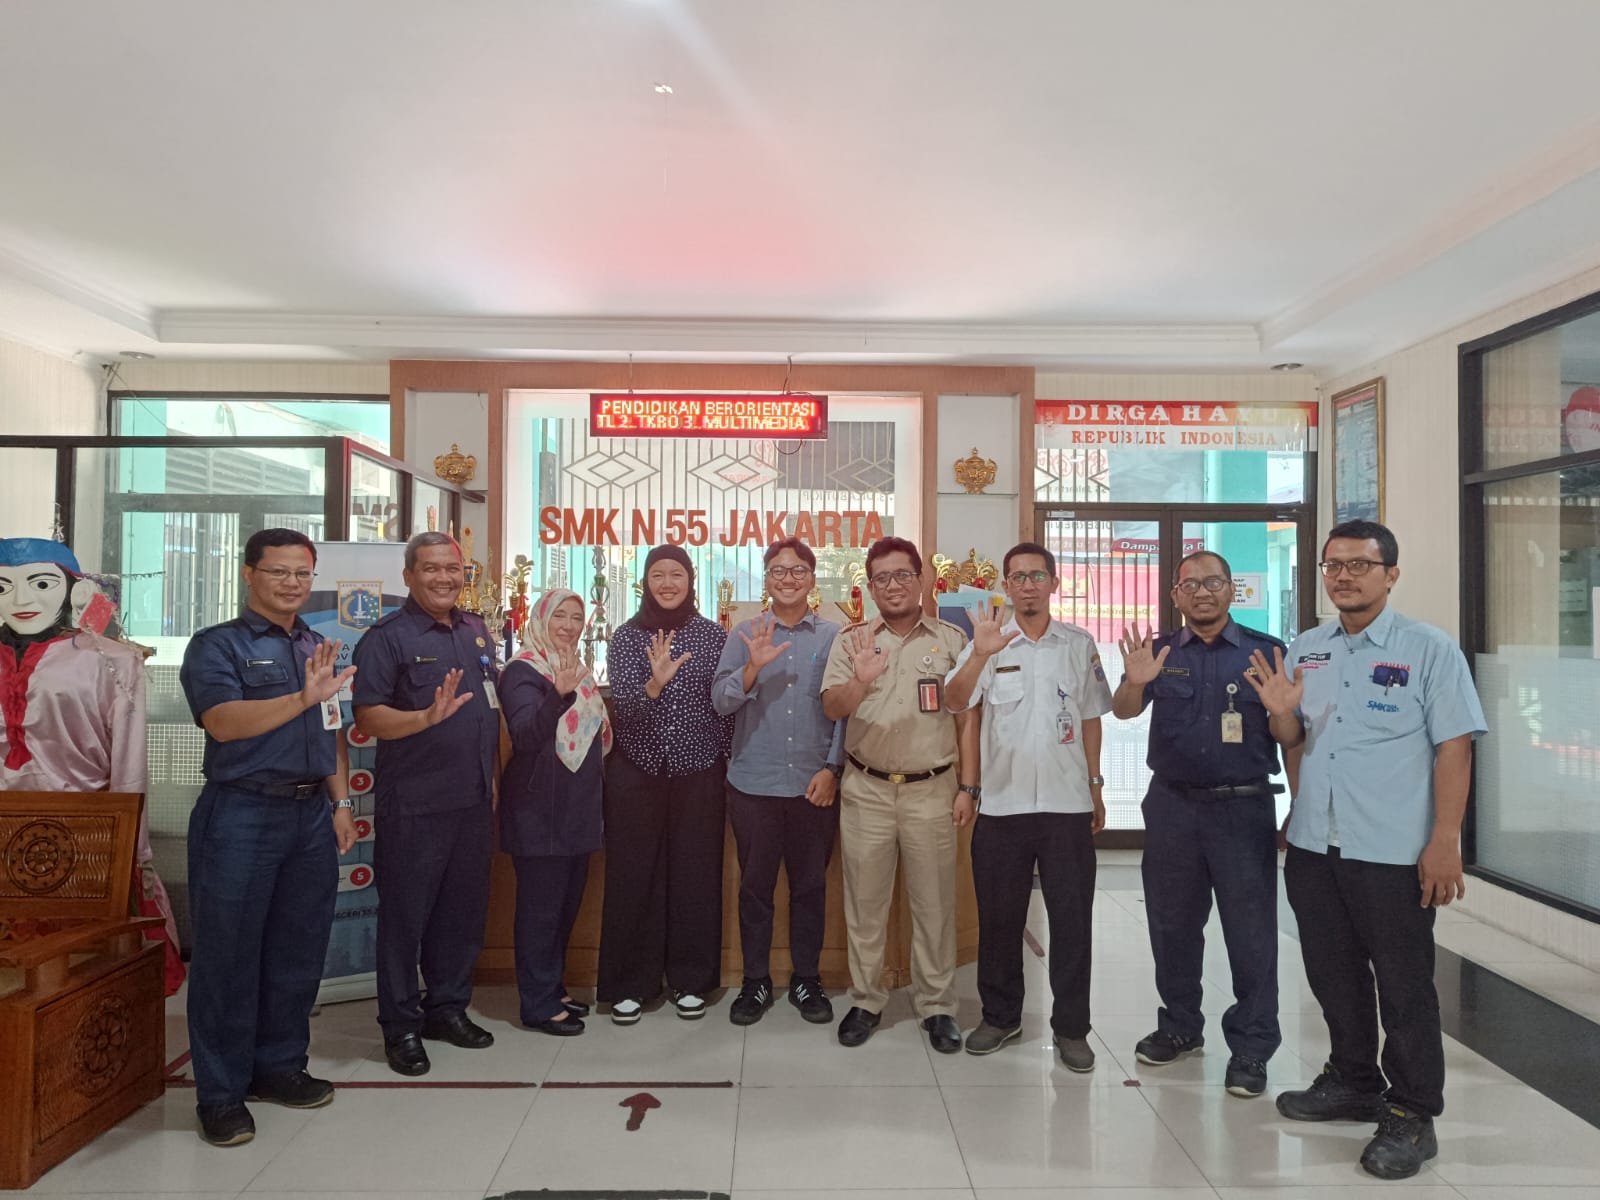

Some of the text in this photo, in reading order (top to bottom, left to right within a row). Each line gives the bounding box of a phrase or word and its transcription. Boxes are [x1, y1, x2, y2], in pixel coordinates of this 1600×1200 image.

[602, 400, 815, 416] PENDIDIKAN BERORIENTASI
[639, 415, 679, 429] TKRO
[1072, 430, 1277, 446] REPUBLIK INDONESIA
[539, 506, 885, 548] SMK N 55 JAKARTA
[1120, 541, 1159, 552] Damp
[356, 777, 365, 786] 3
[357, 871, 365, 880] 5
